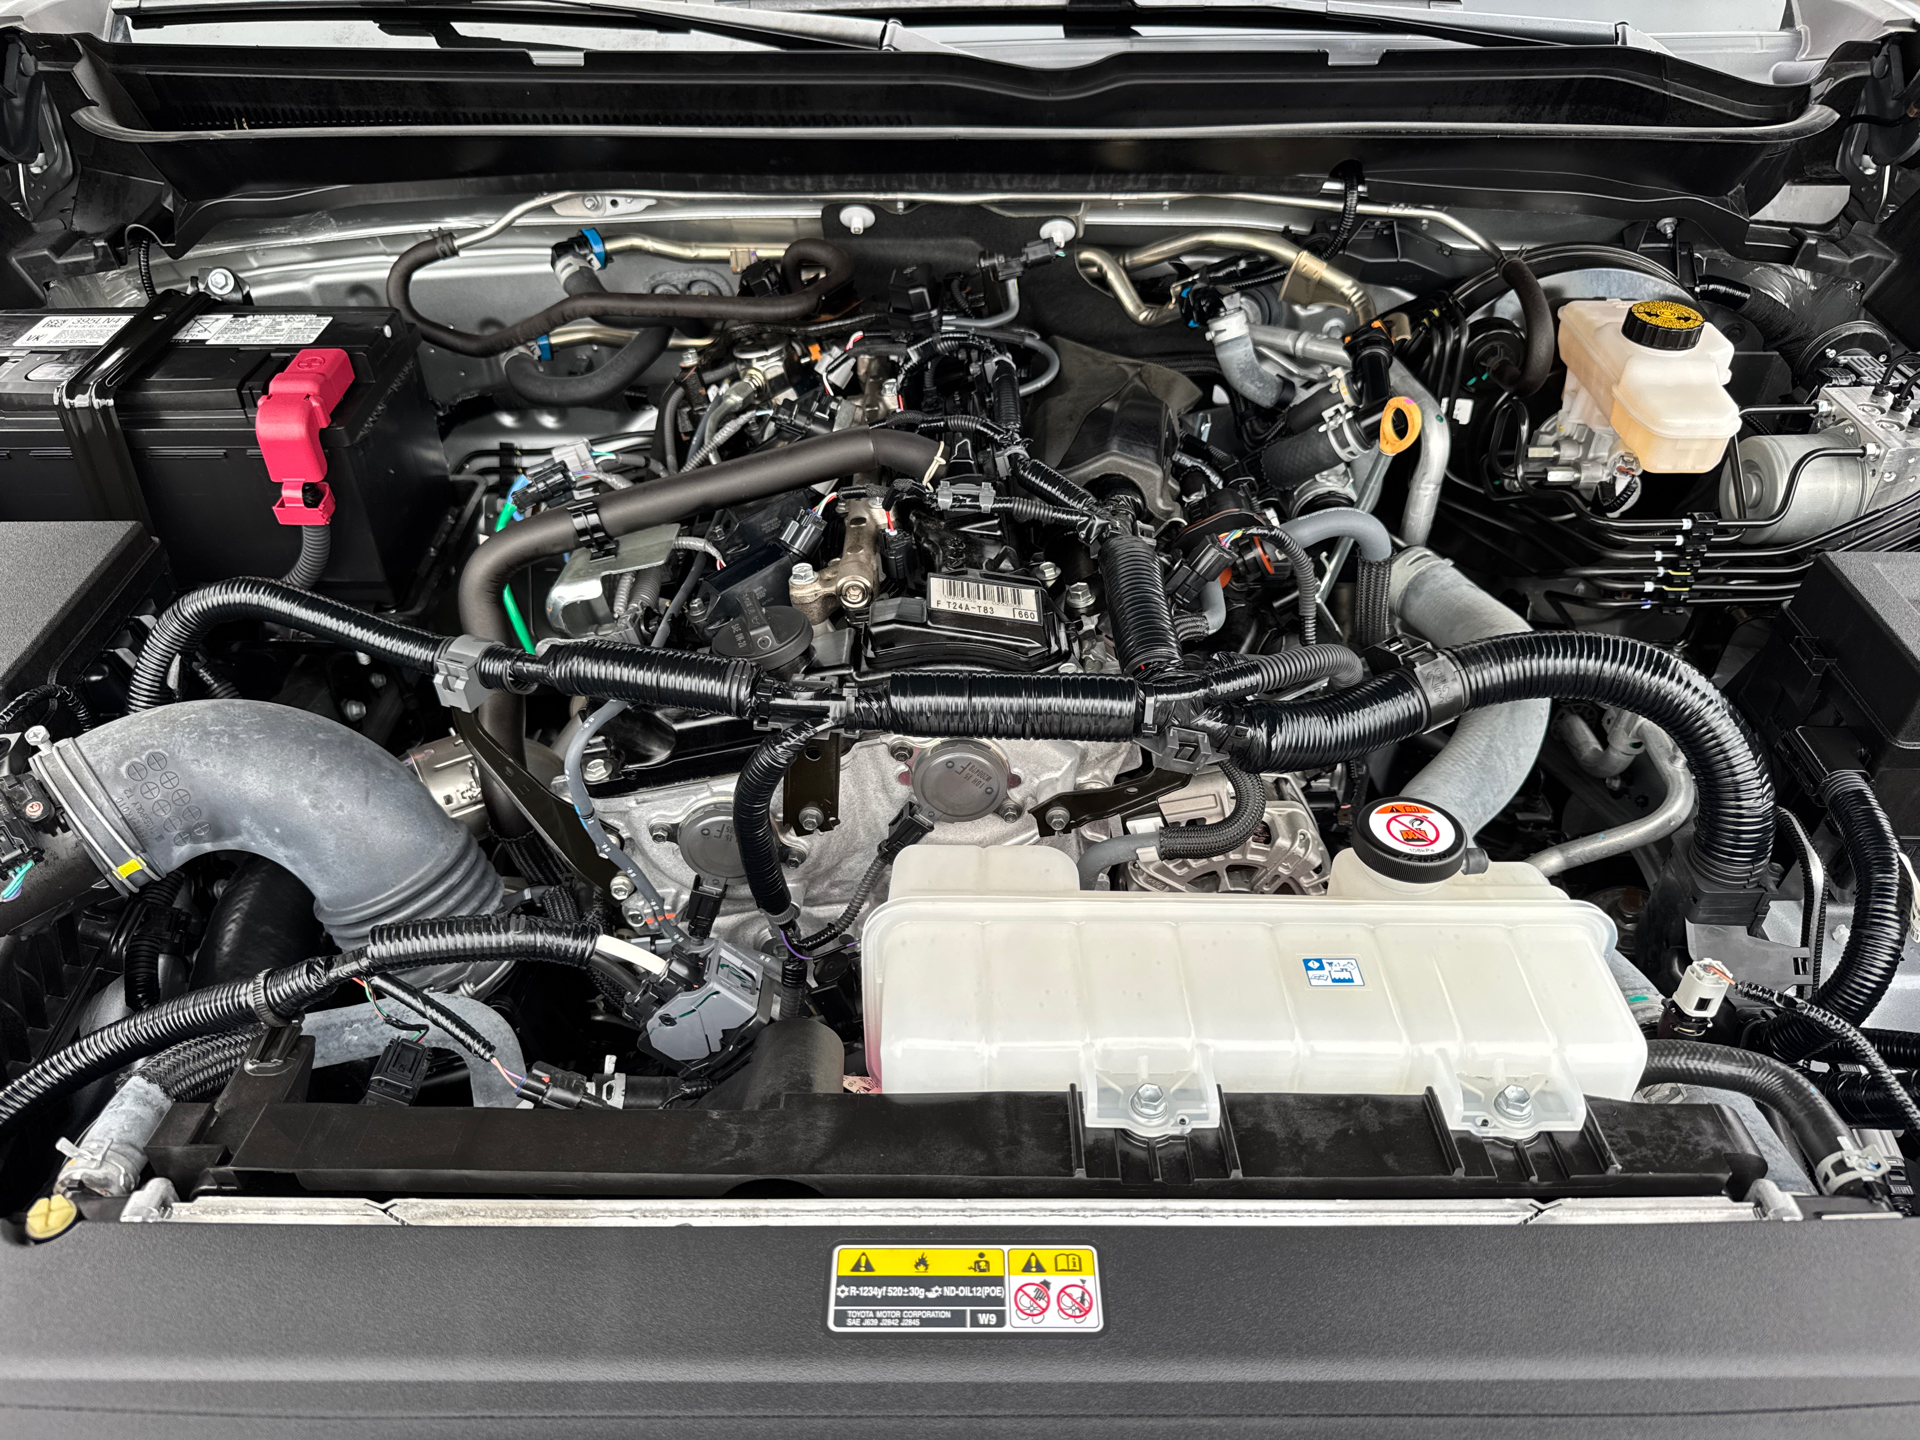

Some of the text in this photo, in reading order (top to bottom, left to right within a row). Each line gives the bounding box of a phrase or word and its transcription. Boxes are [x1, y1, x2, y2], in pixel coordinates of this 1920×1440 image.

[947, 601, 995, 615] T24A-T83
[1018, 611, 1035, 620] 660
[1398, 852, 1448, 863] DENSO
[850, 1286, 1005, 1298] R-1234yf 520±30g ND-OIL12(POE)
[847, 1310, 951, 1318] TOYOTA MOTOR CORPORATION
[977, 1313, 997, 1325] W9
